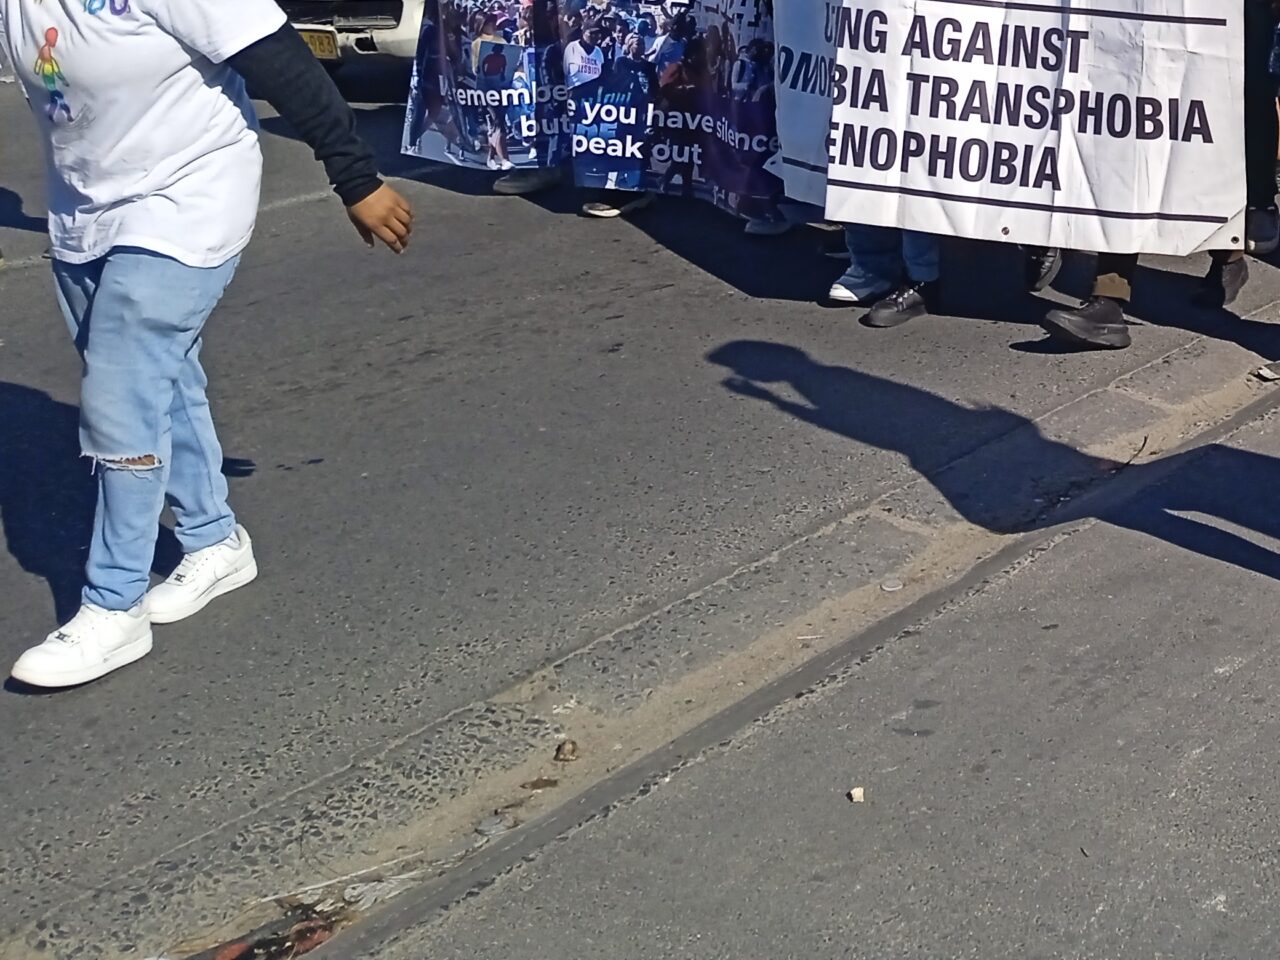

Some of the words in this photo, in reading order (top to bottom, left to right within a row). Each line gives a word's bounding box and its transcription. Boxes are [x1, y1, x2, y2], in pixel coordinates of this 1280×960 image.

[902, 14, 1089, 74] AGAINST
[520, 113, 570, 137] but
[572, 134, 644, 159] peak
[651, 142, 703, 165] out
[581, 100, 637, 125] you
[646, 103, 714, 133] have
[907, 73, 1214, 145] TRANSPHOBIA
[827, 121, 1062, 192] ENOPHOBIA
